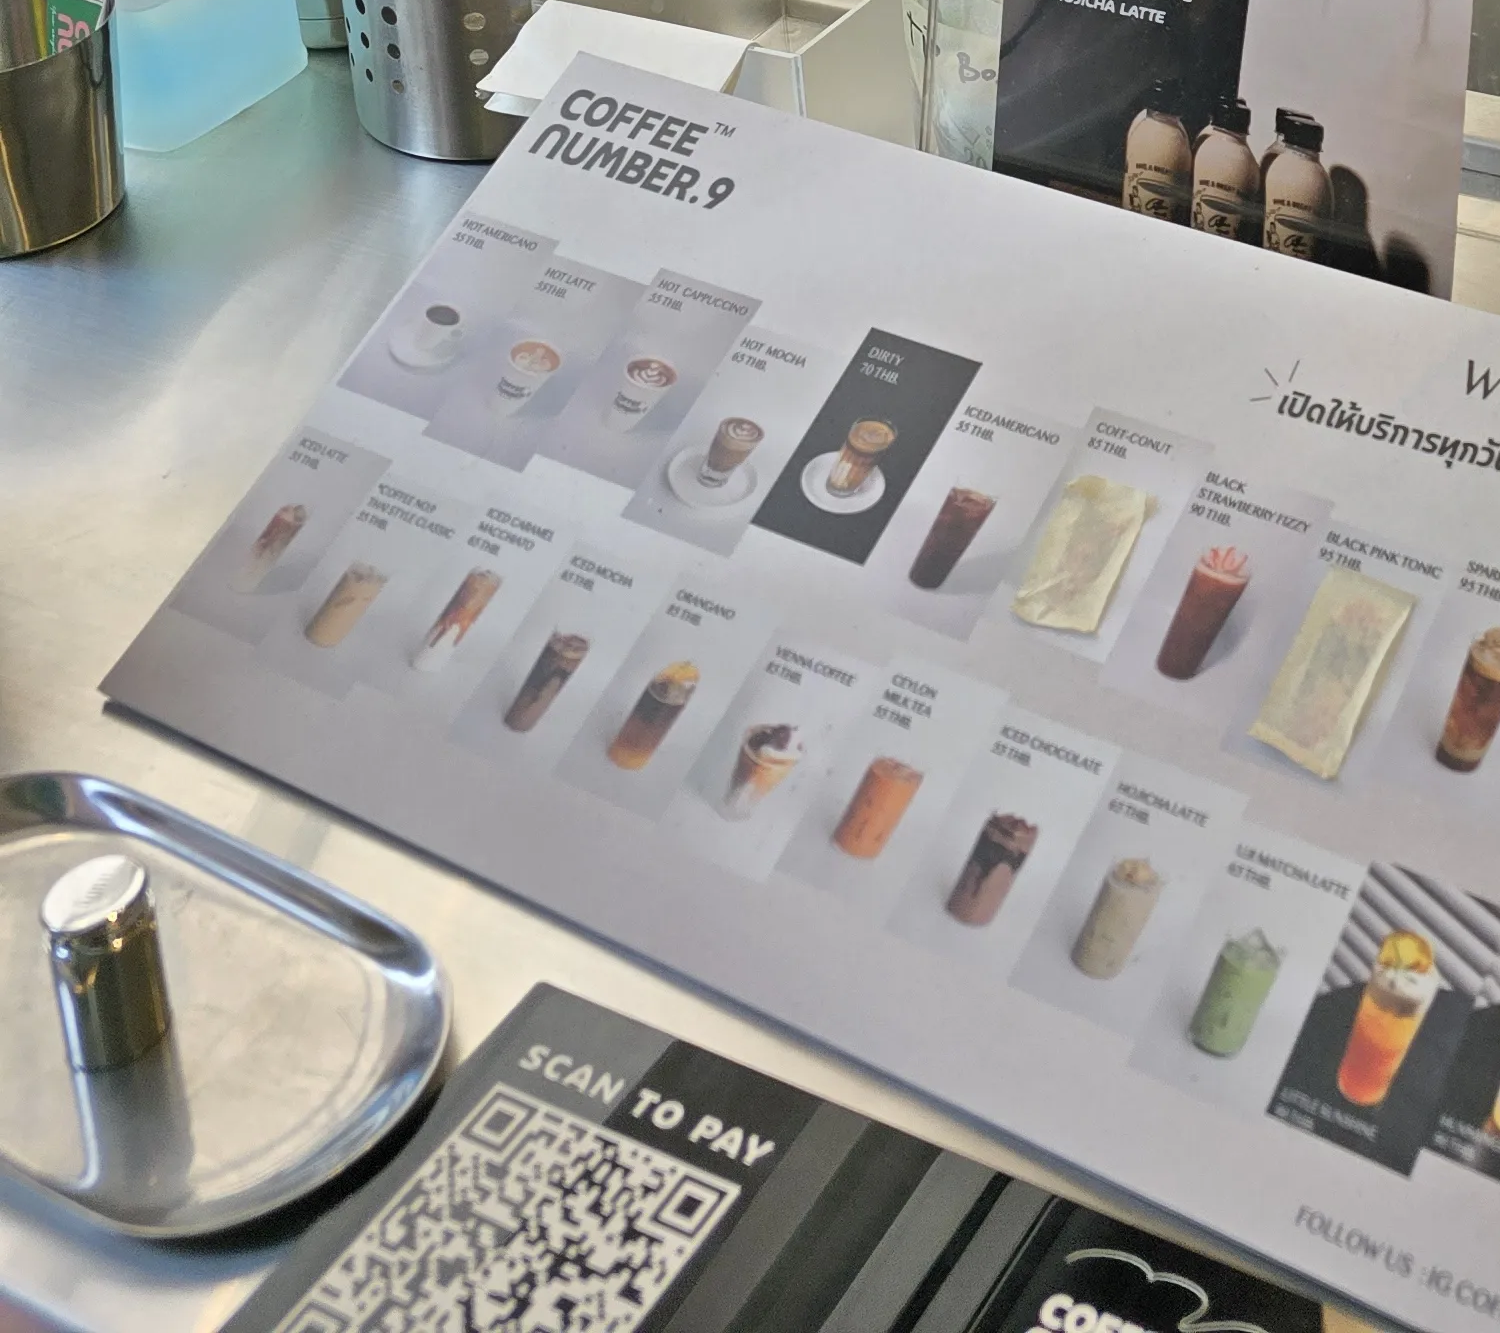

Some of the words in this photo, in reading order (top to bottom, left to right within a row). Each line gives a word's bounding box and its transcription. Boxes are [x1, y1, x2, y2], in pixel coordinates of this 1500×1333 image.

[1119, 2, 1166, 25] LATTE
[559, 89, 709, 157] COFFEE
[462, 218, 484, 235] HOT
[483, 225, 538, 252] AMERICANO
[545, 267, 567, 282] HOT
[566, 272, 597, 292] LATTE
[658, 278, 680, 294] HOT
[682, 285, 749, 317] CAPPUCCINO
[740, 337, 764, 353] HOT
[765, 345, 808, 368] MOCHA
[859, 361, 874, 375] 70
[867, 346, 905, 368] DIRTY
[963, 405, 992, 422] ICED
[991, 412, 1061, 445] AMERICANO
[1205, 471, 1248, 494] BLACK
[1198, 487, 1277, 522] STRAWBERRY
[1275, 511, 1312, 534] FIZZY
[1325, 530, 1371, 557] BLACK
[1370, 543, 1401, 566] PINK
[1401, 553, 1444, 581] TONIC
[518, 1044, 625, 1105] SCAN
[630, 1087, 686, 1130] TO
[688, 1114, 776, 1167] PAY
[1294, 1205, 1384, 1262] FOLLOW
[1384, 1246, 1416, 1278] US
